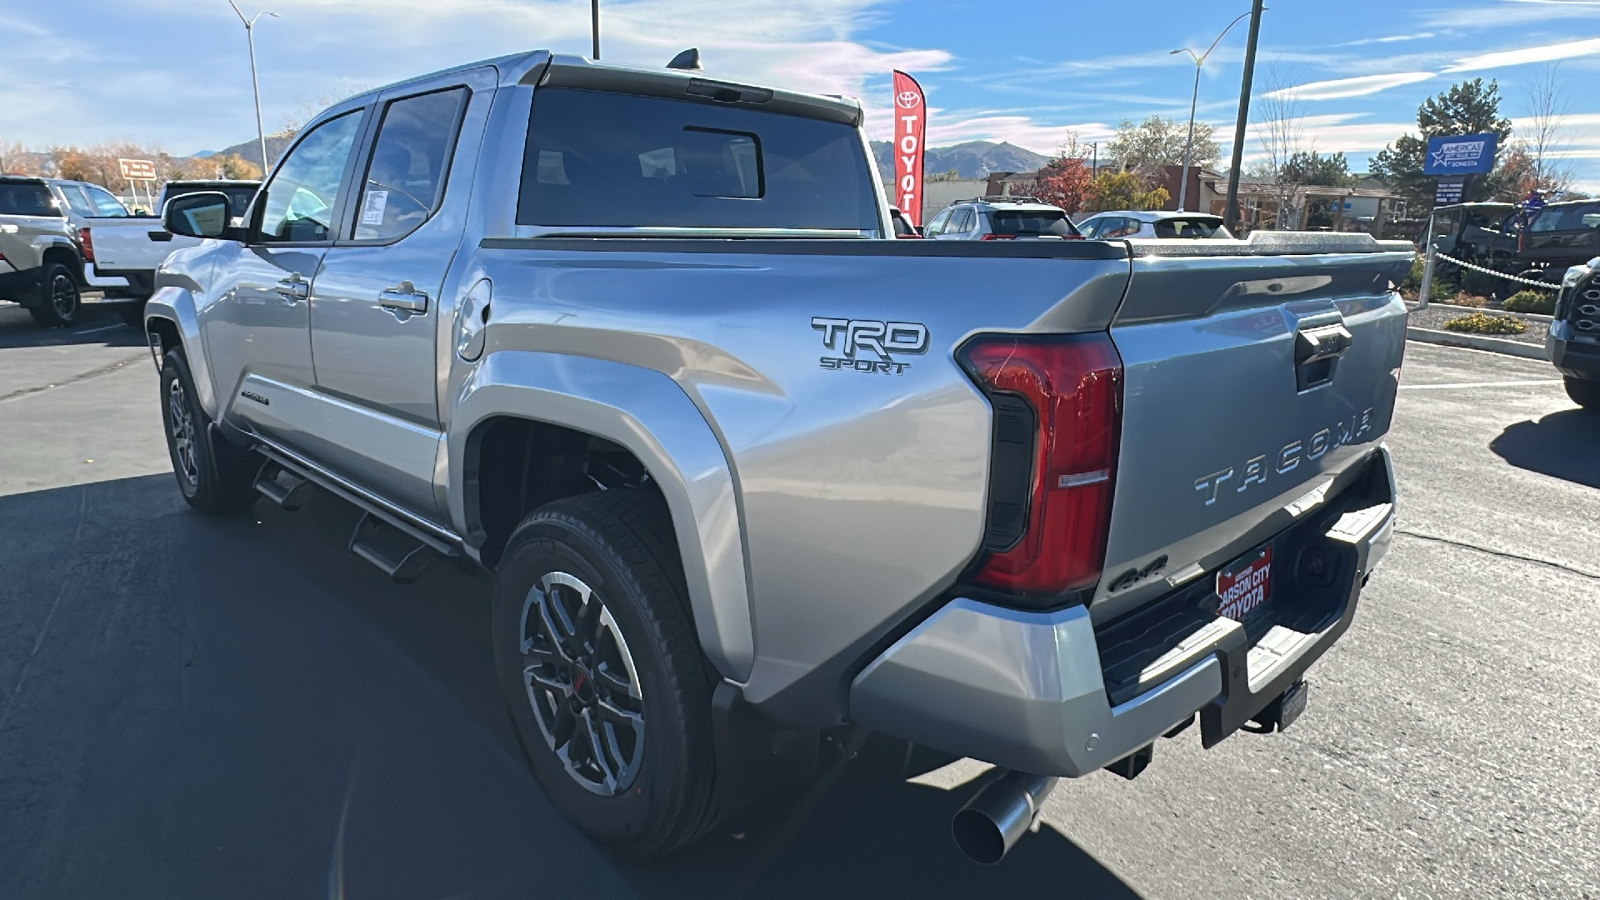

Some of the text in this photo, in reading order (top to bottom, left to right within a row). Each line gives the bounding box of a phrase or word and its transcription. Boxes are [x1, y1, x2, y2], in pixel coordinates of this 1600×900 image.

[1445, 144, 1481, 152] AMERICAS
[901, 115, 918, 229] TOYOTA
[811, 317, 931, 362] TRD
[819, 356, 912, 376] SPORT
[1194, 406, 1374, 506] TACOMA
[1252, 562, 1271, 588] CITY
[1221, 584, 1264, 620] TOYOTA
